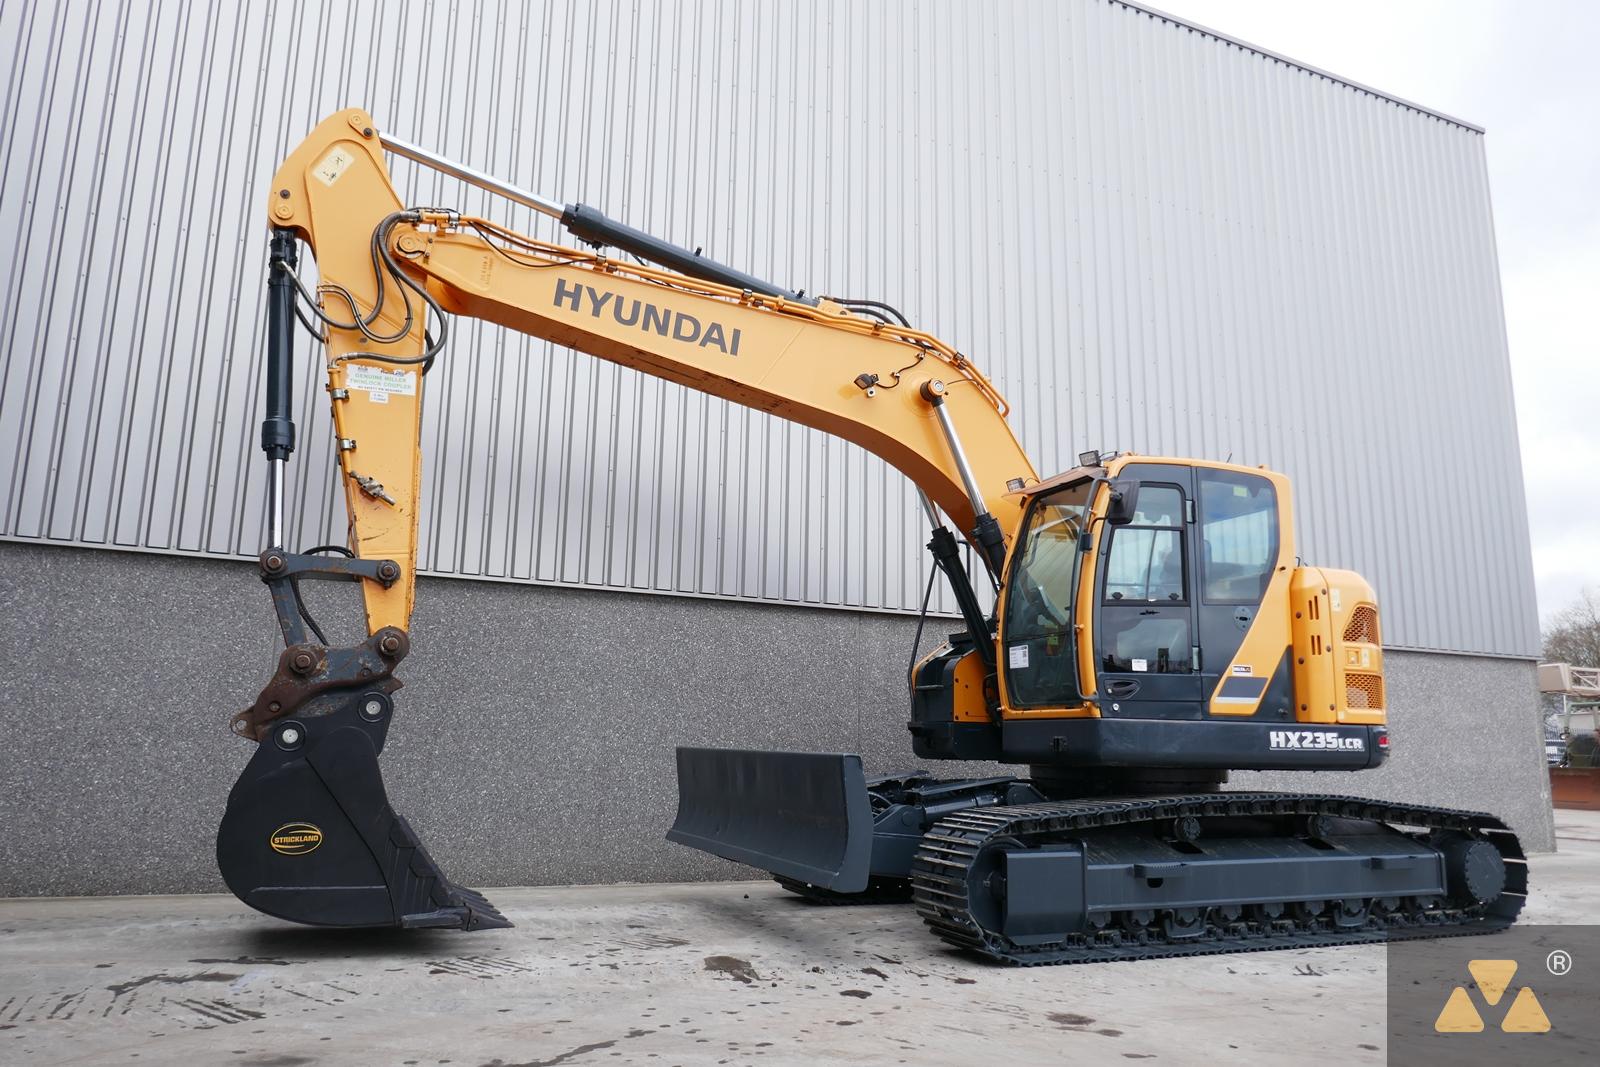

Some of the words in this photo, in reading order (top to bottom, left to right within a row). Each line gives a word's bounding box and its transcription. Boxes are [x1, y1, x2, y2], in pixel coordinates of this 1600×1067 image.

[553, 278, 742, 356] HYUNDAI
[1269, 731, 1364, 750] HX235LCR
[274, 835, 319, 844] STRICKLAND
